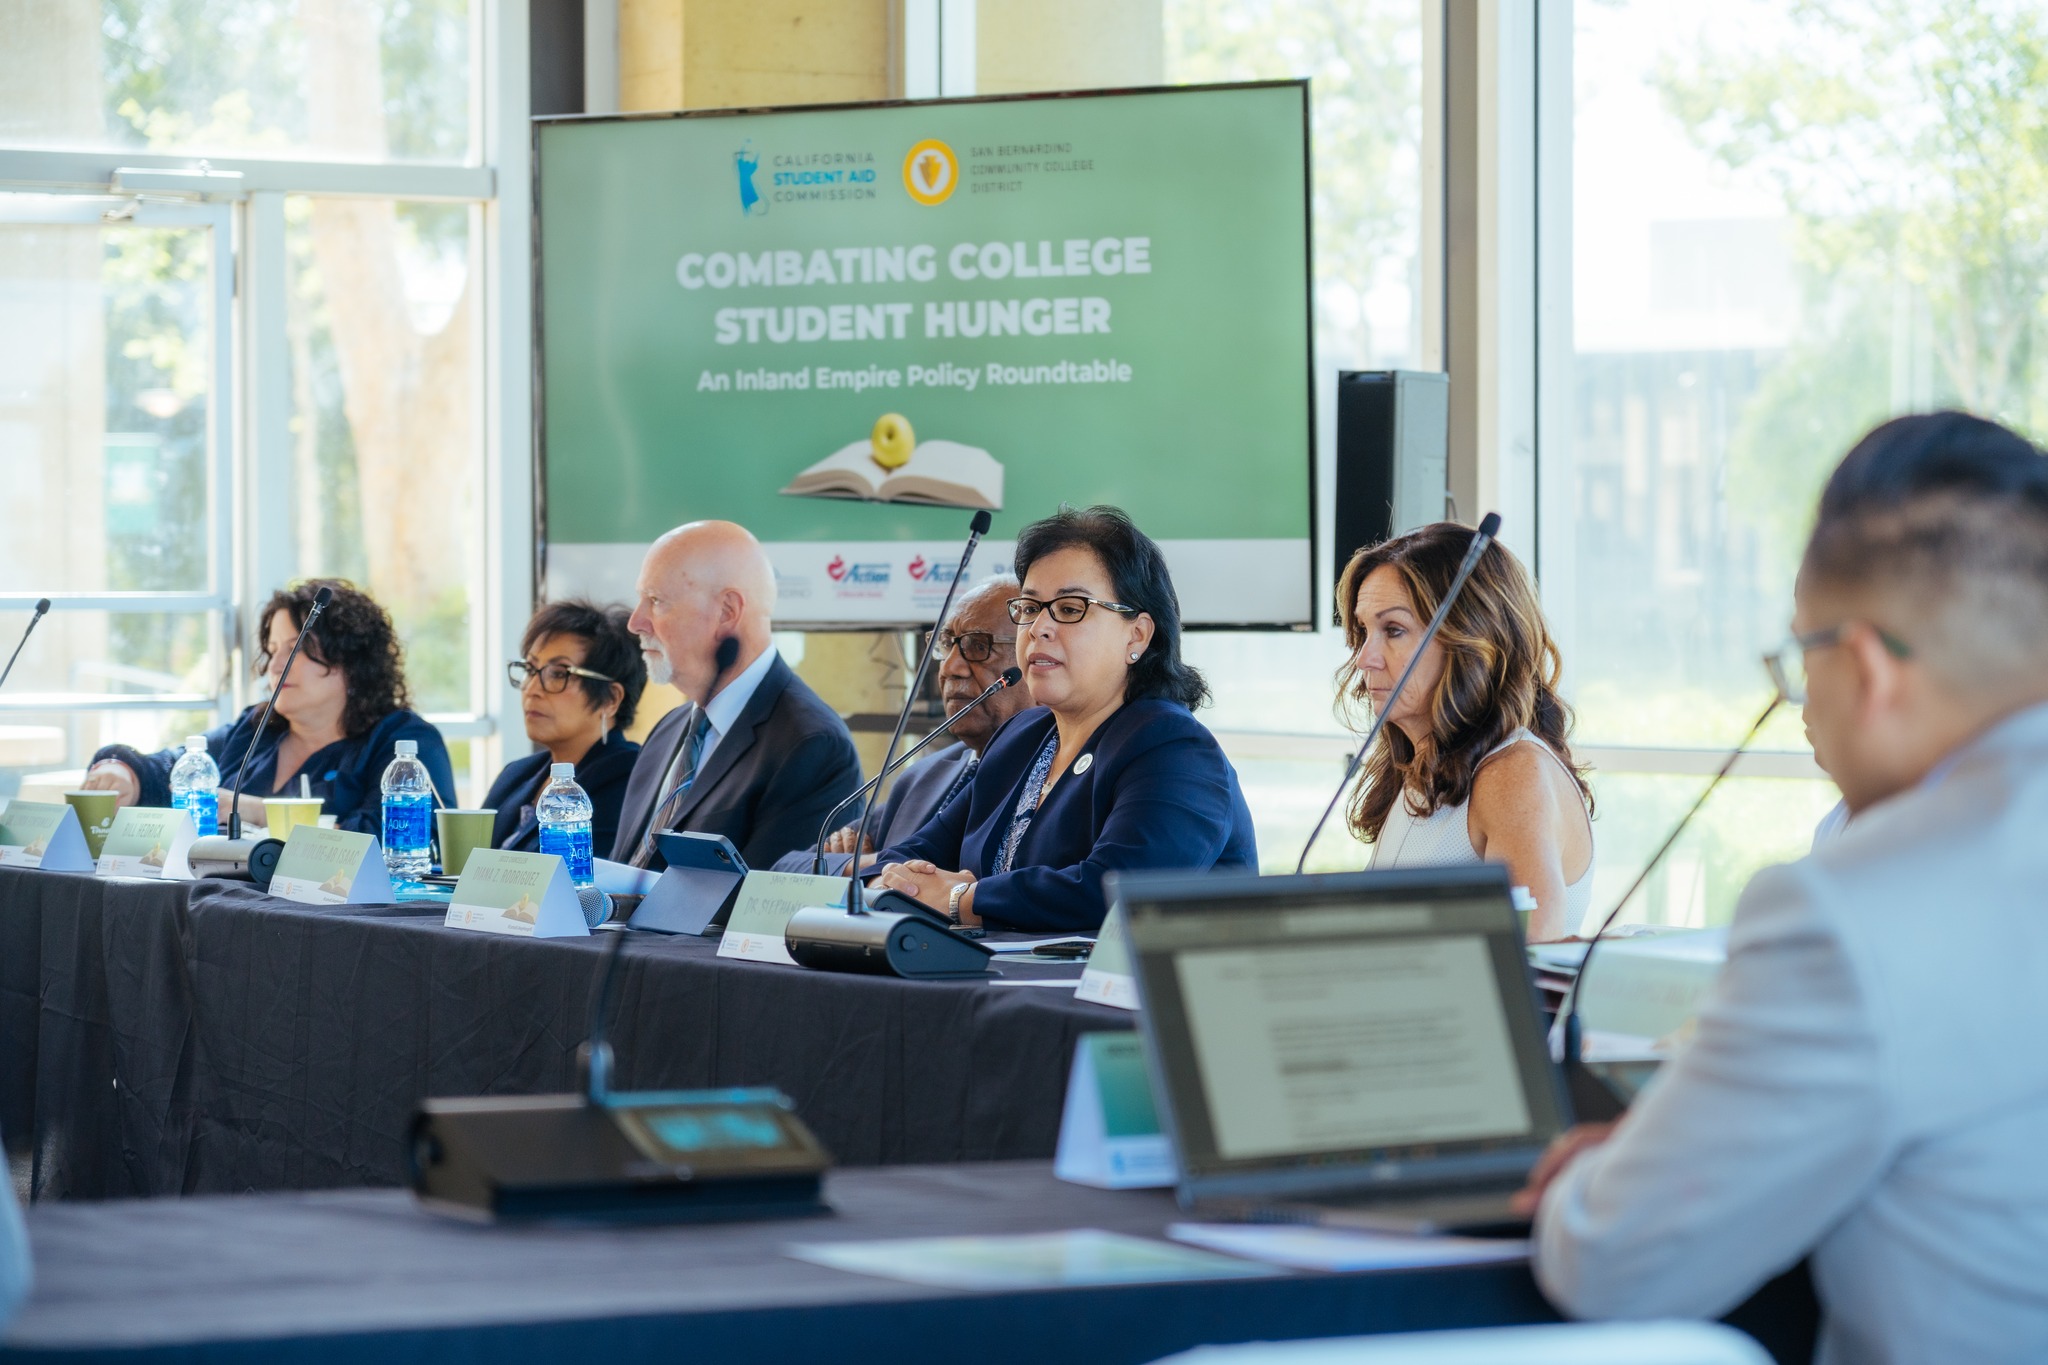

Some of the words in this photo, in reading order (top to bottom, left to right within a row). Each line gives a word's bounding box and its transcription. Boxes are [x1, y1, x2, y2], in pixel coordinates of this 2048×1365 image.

[970, 146, 993, 157] SAN
[997, 142, 1073, 156] BERNARDINO
[773, 152, 875, 168] CALIFORNIA
[970, 162, 1040, 175] COMMUNITY
[1043, 159, 1094, 171] COLLEGE
[773, 170, 845, 187] STUDENT
[848, 169, 876, 184] AID
[970, 181, 1023, 193] DISTRICT
[773, 188, 877, 203] COMMISSION
[676, 244, 937, 290] COMBATING
[948, 236, 1152, 281] COLLEGE
[714, 303, 912, 345] STUDENT
[925, 297, 1112, 338] HUNGER
[697, 370, 730, 392] An
[735, 366, 810, 391] Inland
[815, 364, 901, 393] Empire
[907, 361, 980, 391] Policy
[986, 358, 1132, 386] Roundtable
